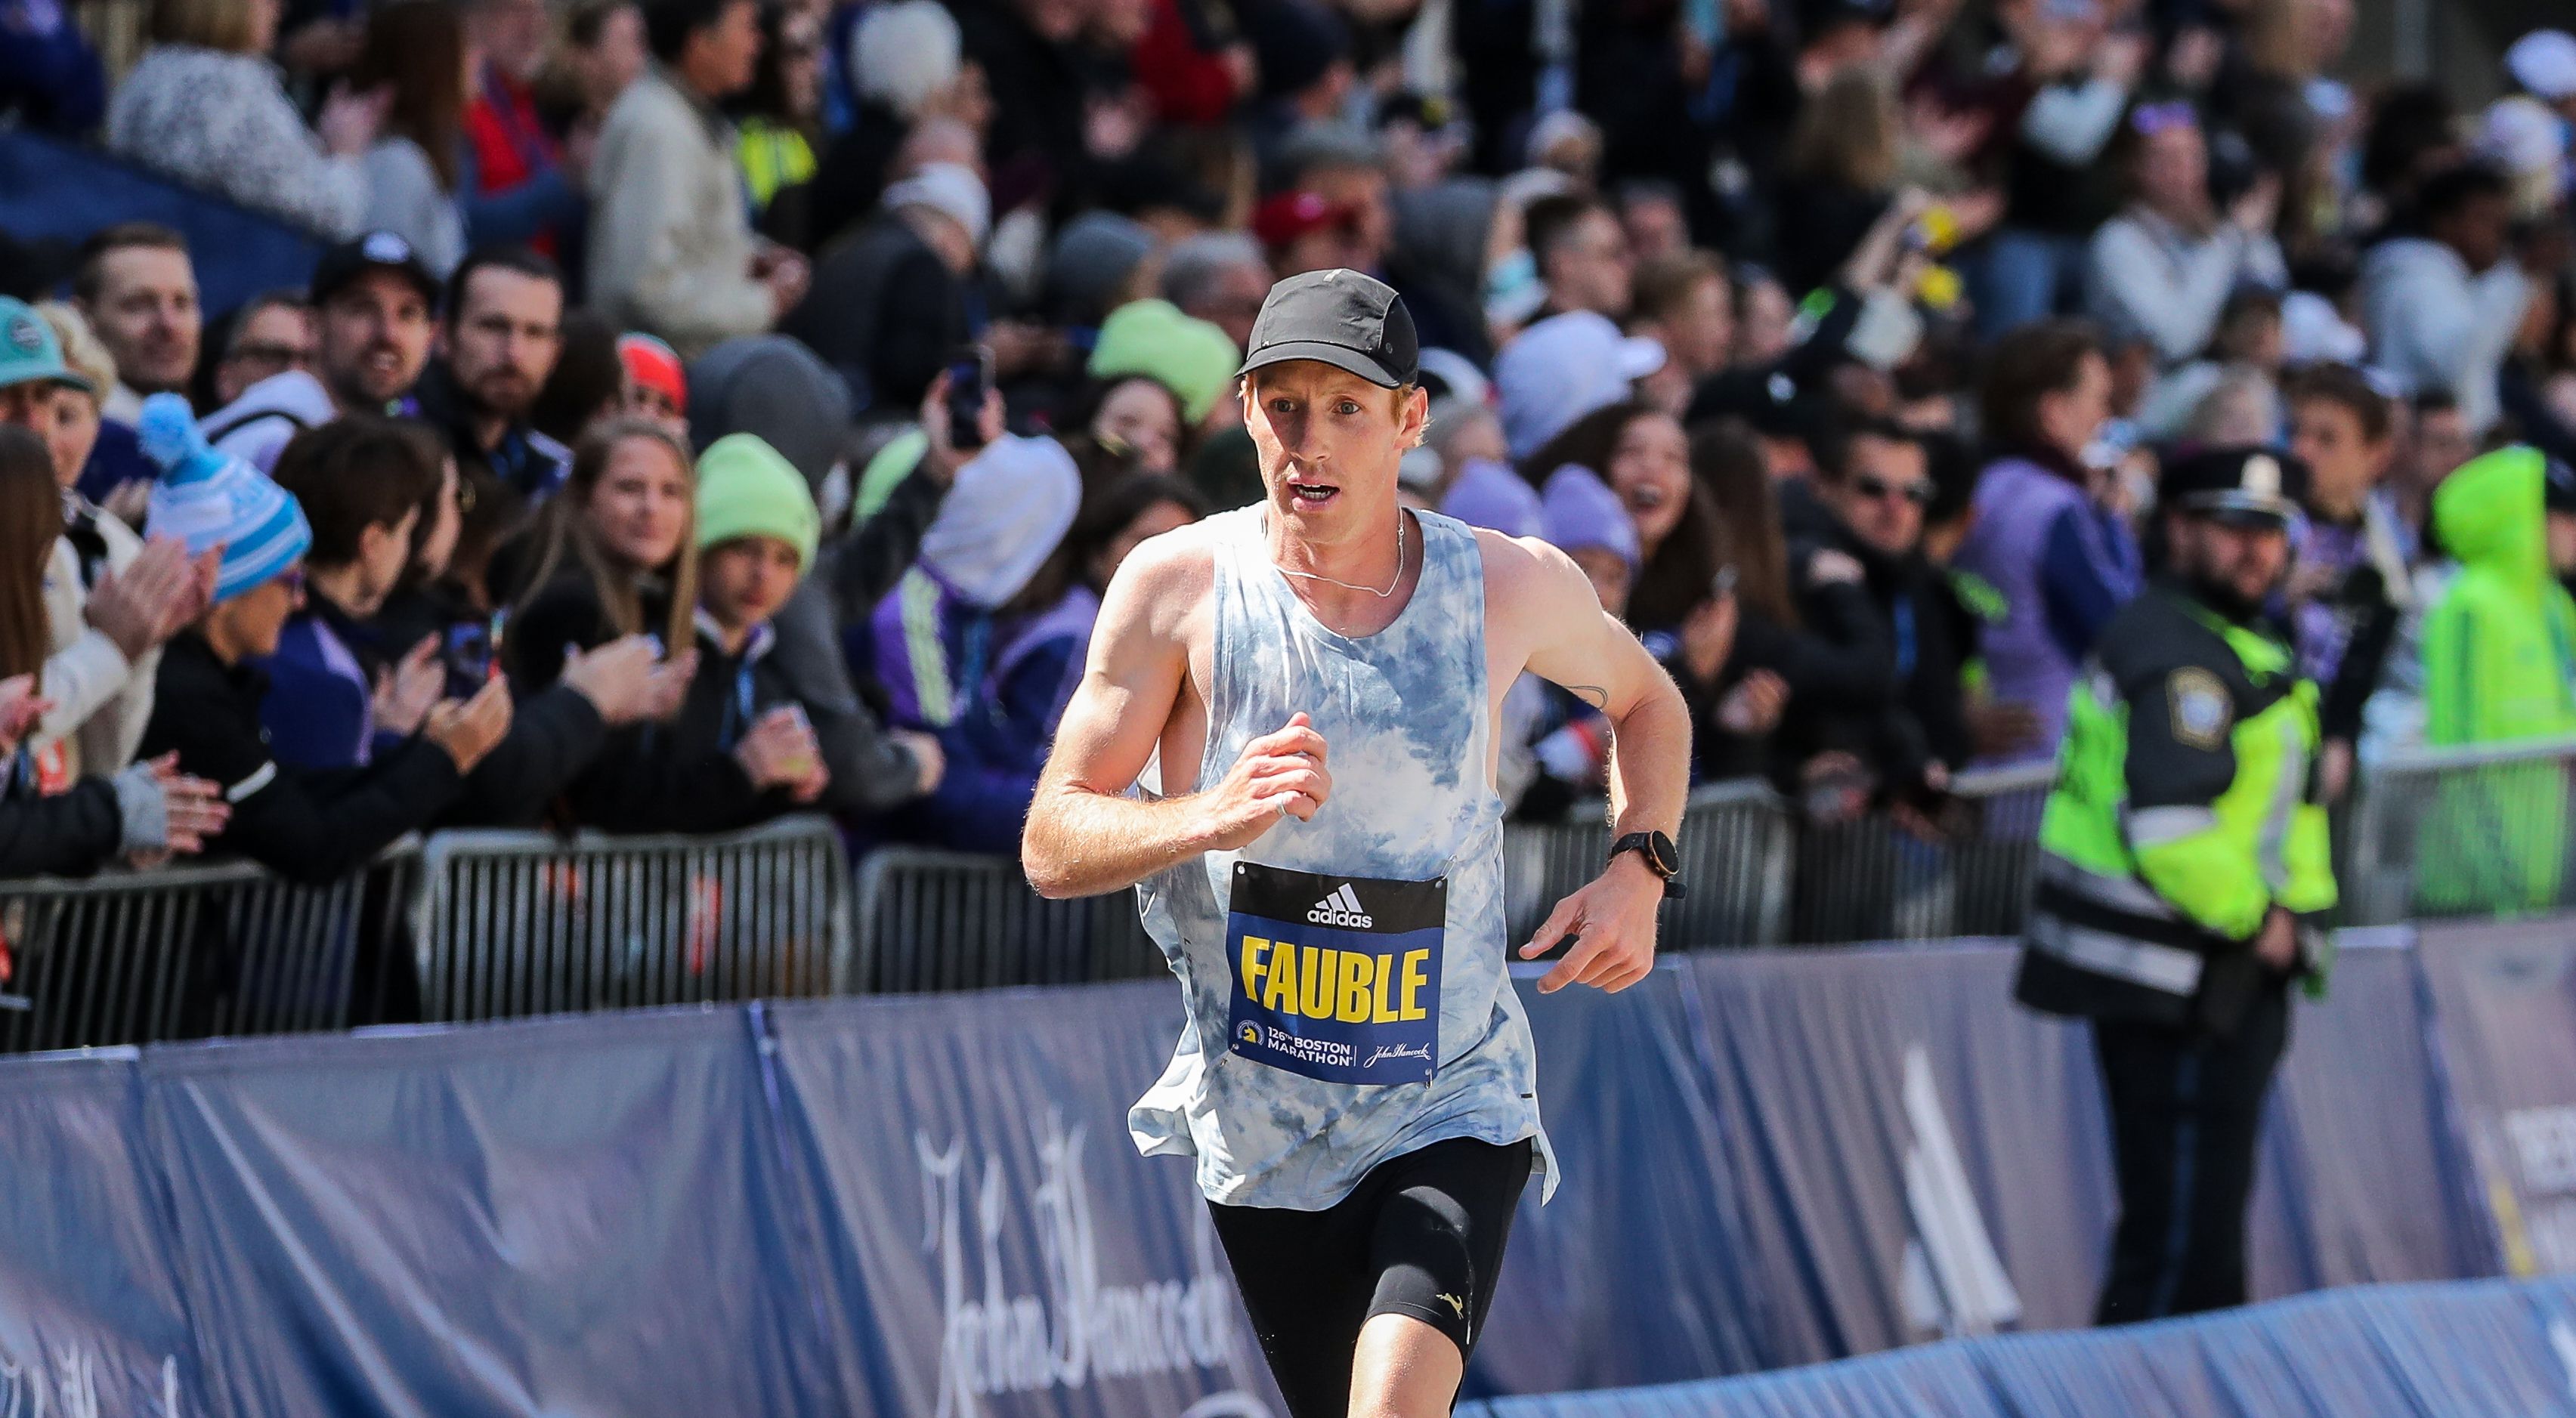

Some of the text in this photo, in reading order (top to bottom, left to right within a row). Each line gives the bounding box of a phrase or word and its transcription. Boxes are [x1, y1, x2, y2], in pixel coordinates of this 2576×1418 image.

[1307, 909, 1372, 928] adidas
[1241, 935, 1429, 1024] FAUBLE
[1268, 1038, 1350, 1067] MARATHON
[1294, 1037, 1350, 1055] BOSTON
[1363, 1043, 1431, 1068] John Hancock
